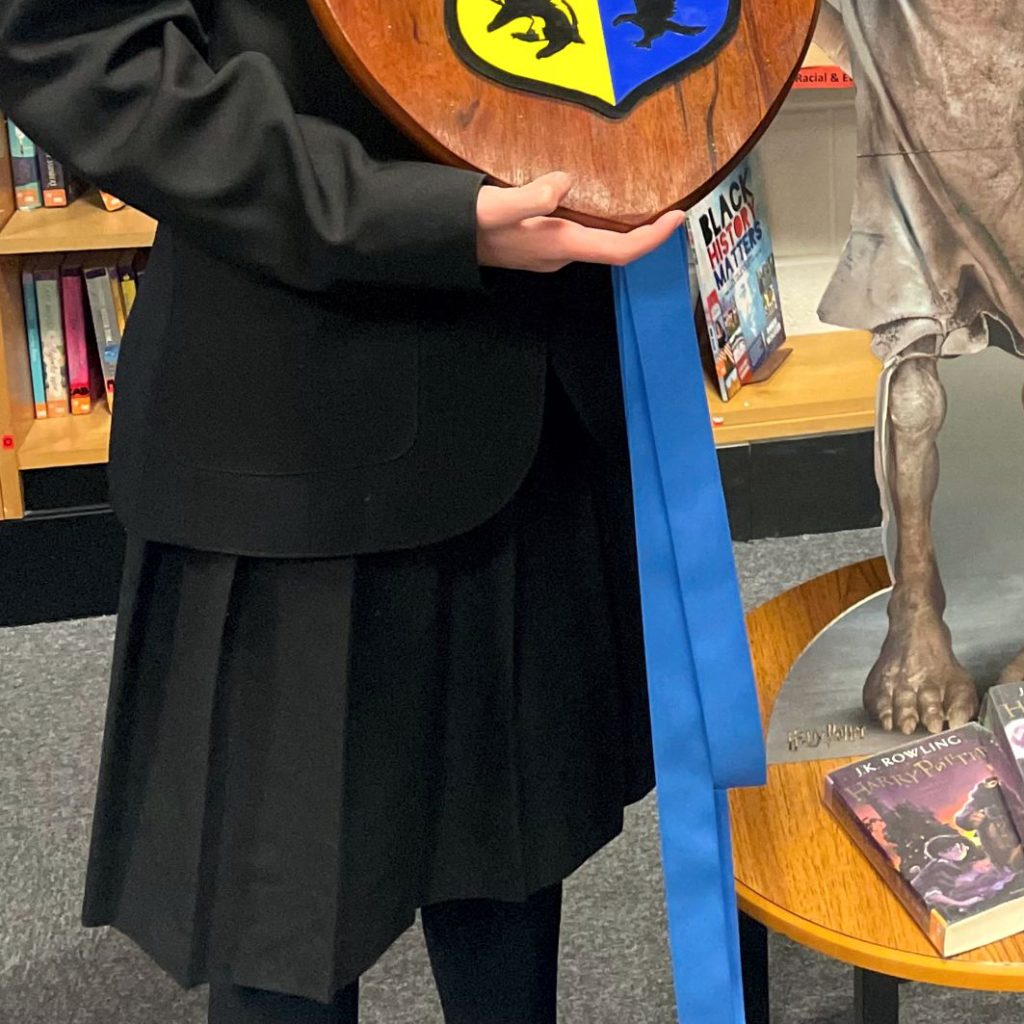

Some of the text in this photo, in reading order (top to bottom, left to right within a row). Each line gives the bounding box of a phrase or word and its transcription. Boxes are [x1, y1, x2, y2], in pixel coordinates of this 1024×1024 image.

[795, 72, 828, 83] Racial
[830, 72, 839, 83] &
[699, 167, 755, 246] BLACK
[707, 202, 757, 270] HISTORY
[713, 220, 763, 290] MATTERS
[880, 734, 963, 769] ROWLING
[844, 767, 921, 802] HARRY
